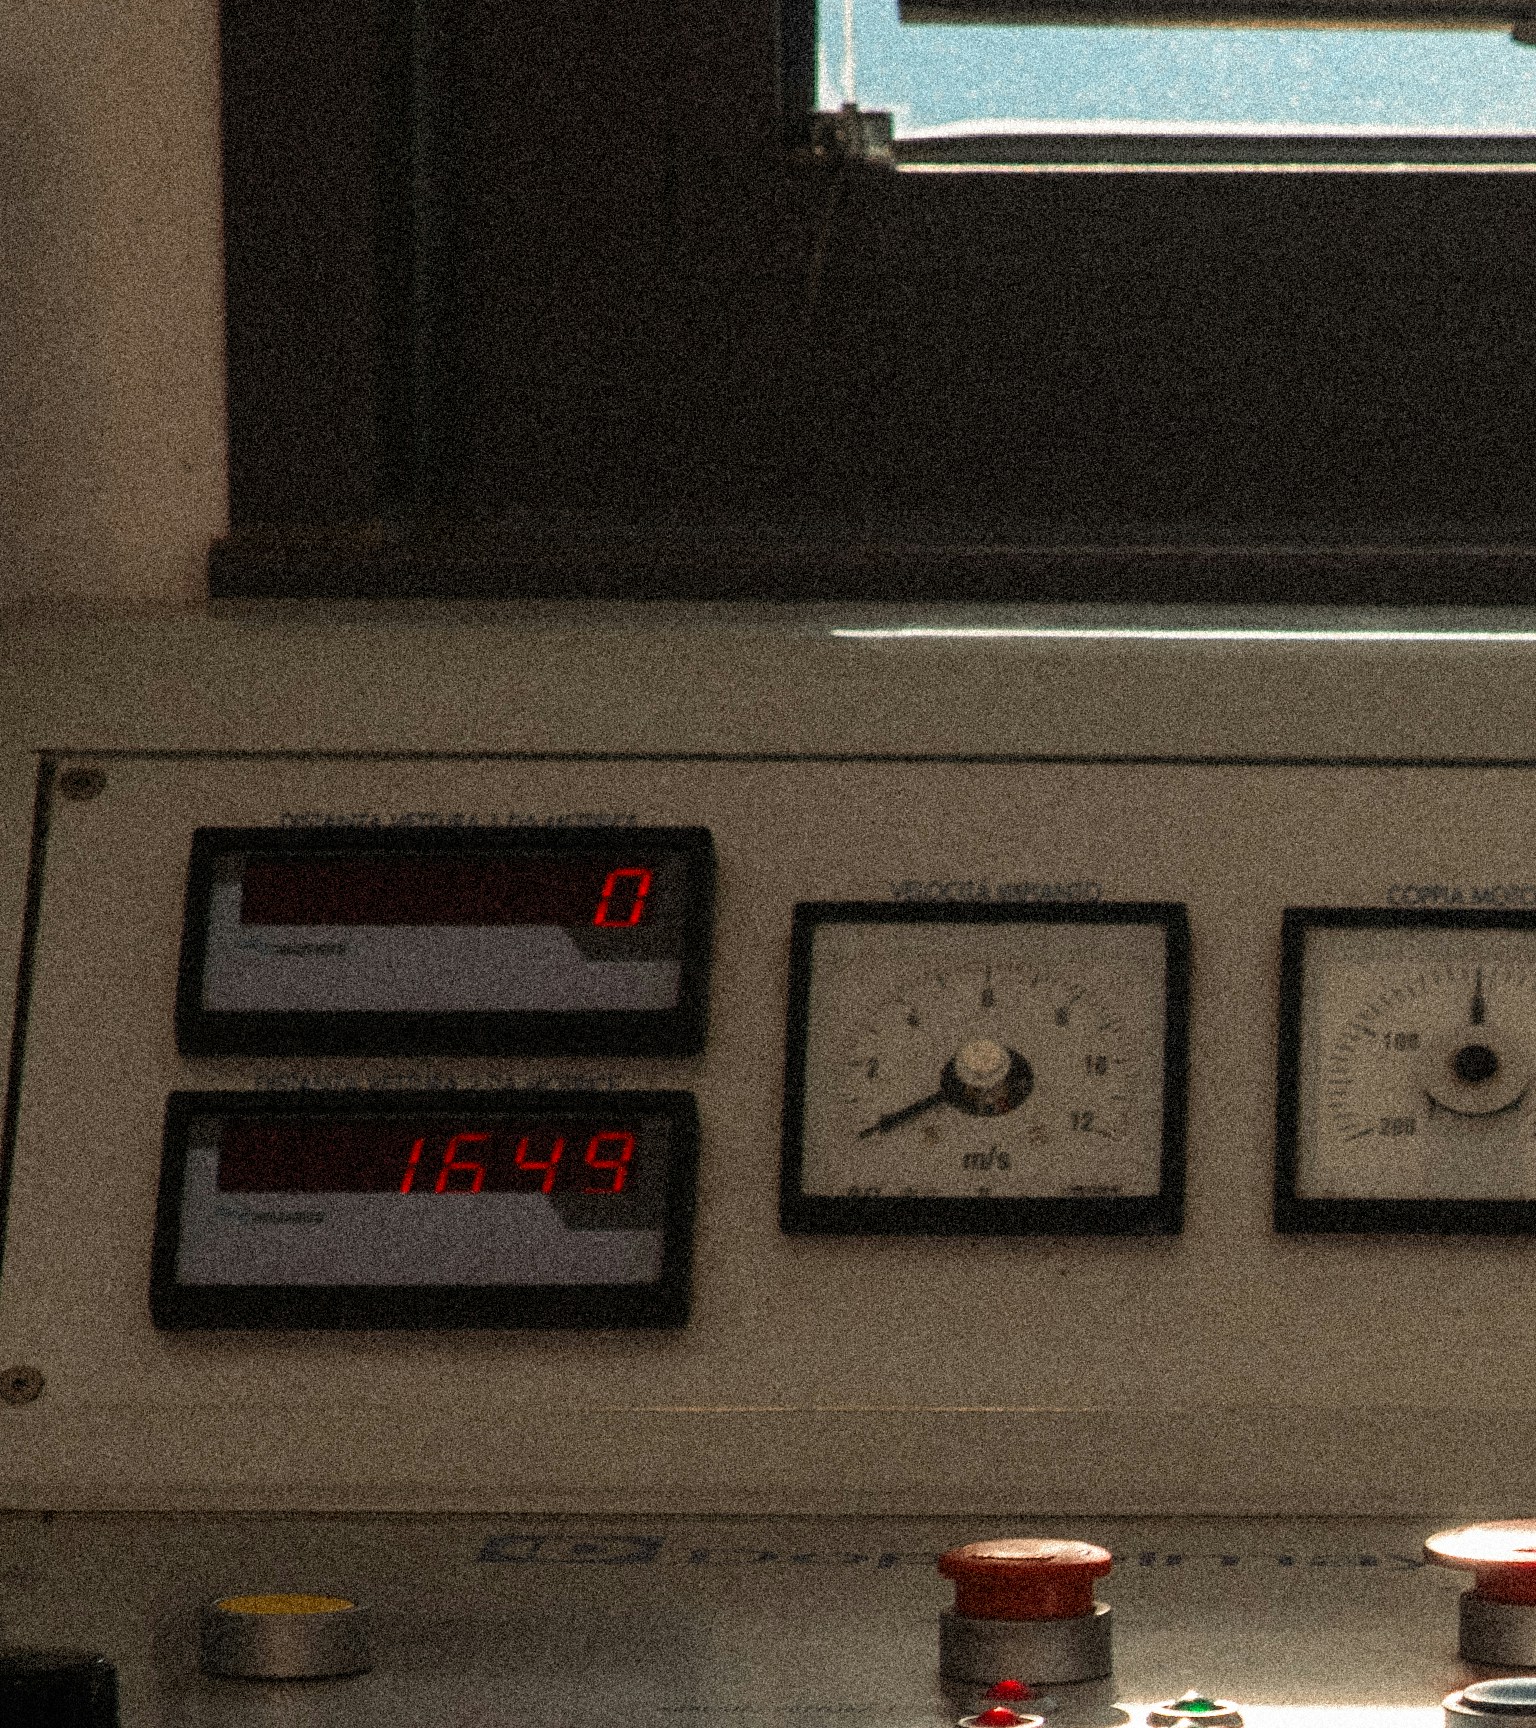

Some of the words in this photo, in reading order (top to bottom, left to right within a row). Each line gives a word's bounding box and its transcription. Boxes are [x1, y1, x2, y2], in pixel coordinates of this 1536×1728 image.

[593, 868, 652, 927] 0
[1387, 885, 1465, 905] COPPIA
[1071, 1112, 1094, 1131] 12
[400, 1132, 635, 1194] 1649
[962, 1146, 1010, 1170] m/s
